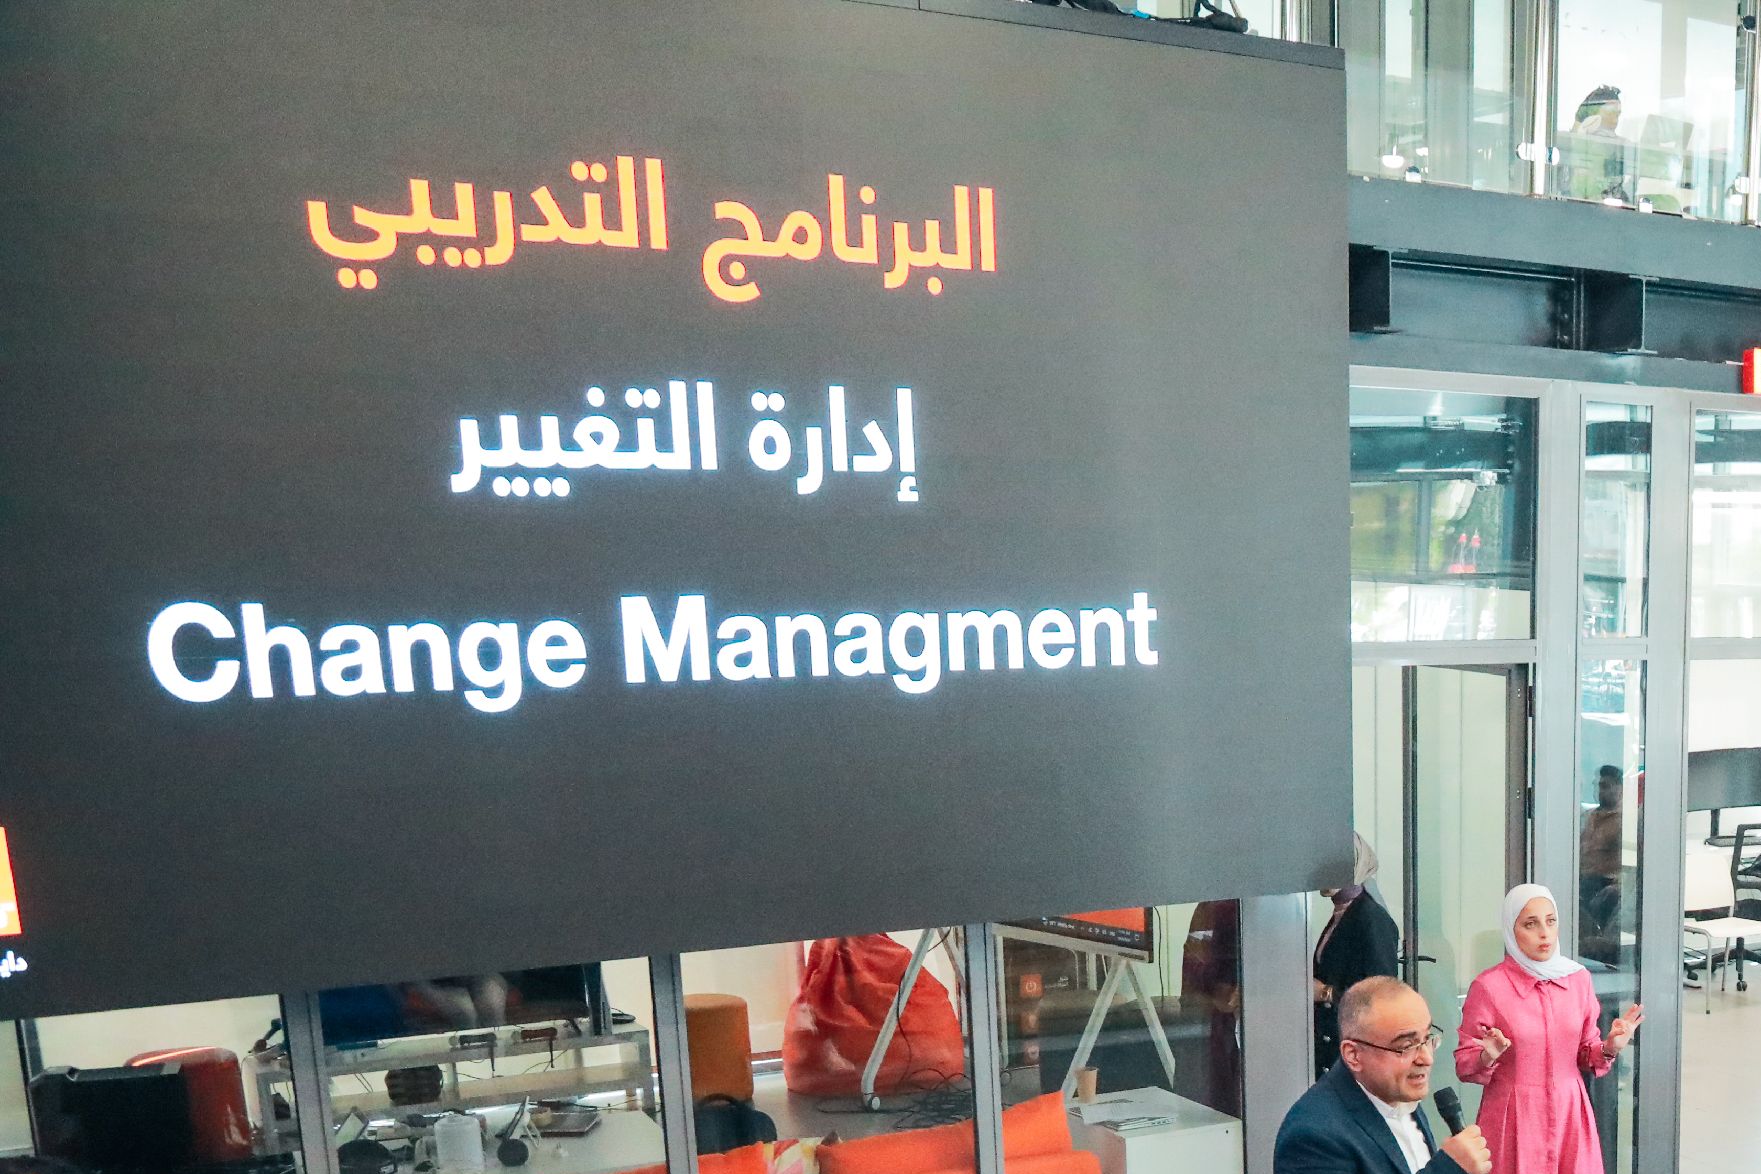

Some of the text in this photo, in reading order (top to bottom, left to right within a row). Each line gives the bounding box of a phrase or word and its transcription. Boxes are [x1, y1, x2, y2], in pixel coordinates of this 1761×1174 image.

[306, 155, 998, 304] البرنامج التدريبي
[450, 380, 919, 502] إدارة التغيير
[147, 591, 1159, 713] Change Managment
